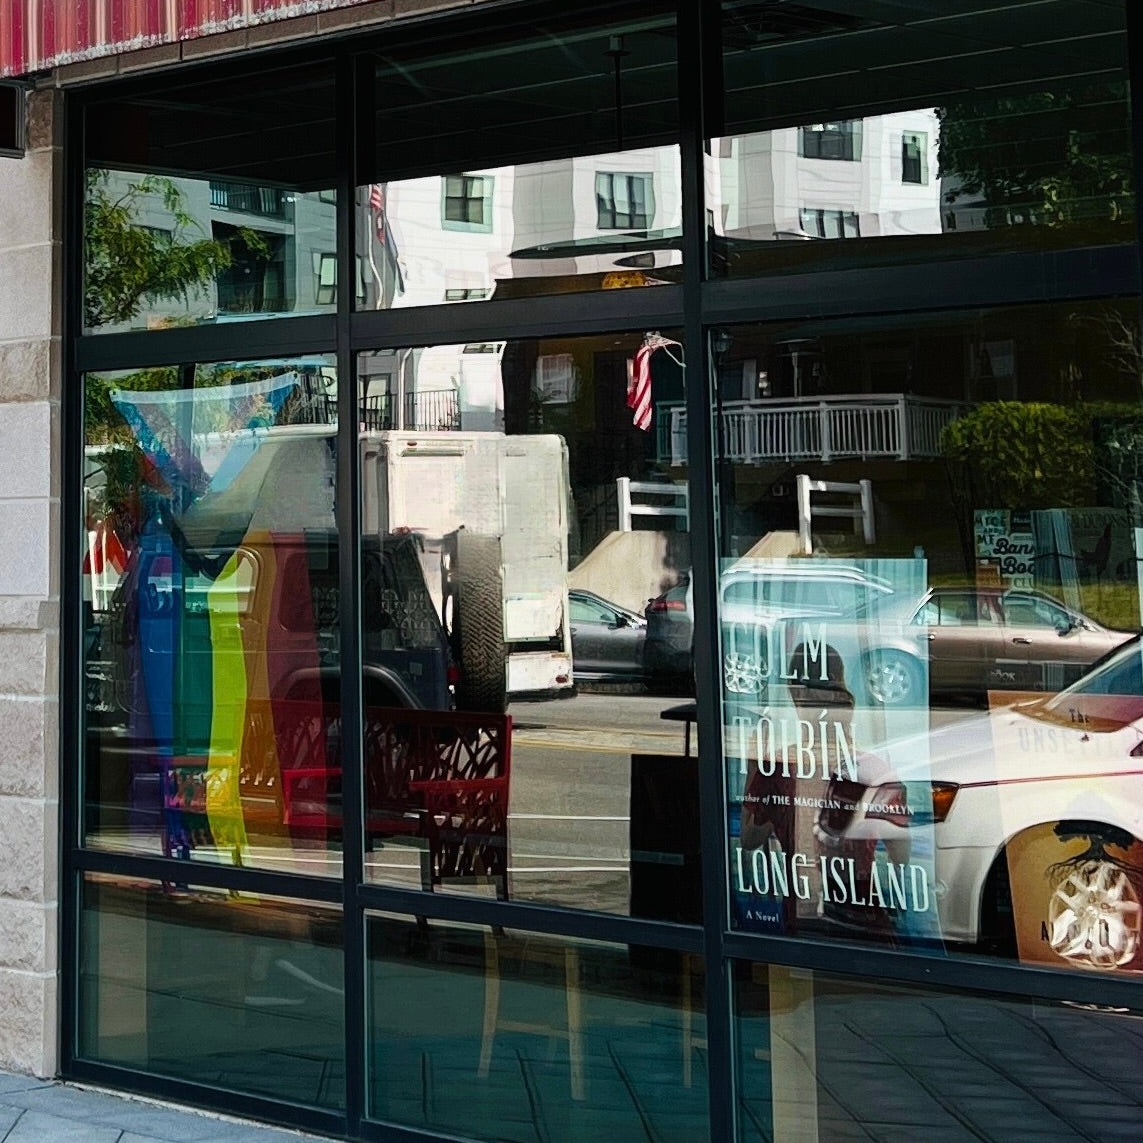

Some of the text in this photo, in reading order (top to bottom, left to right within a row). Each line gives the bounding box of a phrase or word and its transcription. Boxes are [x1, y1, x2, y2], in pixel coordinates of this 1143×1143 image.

[1000, 556, 1035, 574] Boo
[1014, 577, 1035, 588] CLU
[732, 706, 858, 782] TÓIBÍN
[762, 794, 770, 805] of
[772, 795, 791, 805] THE
[793, 797, 841, 810] MAGICIAN
[844, 803, 859, 811] and
[862, 802, 915, 816] BROOKLYN
[736, 847, 929, 912] LONG ISLAND
[746, 910, 780, 923] A Novel
